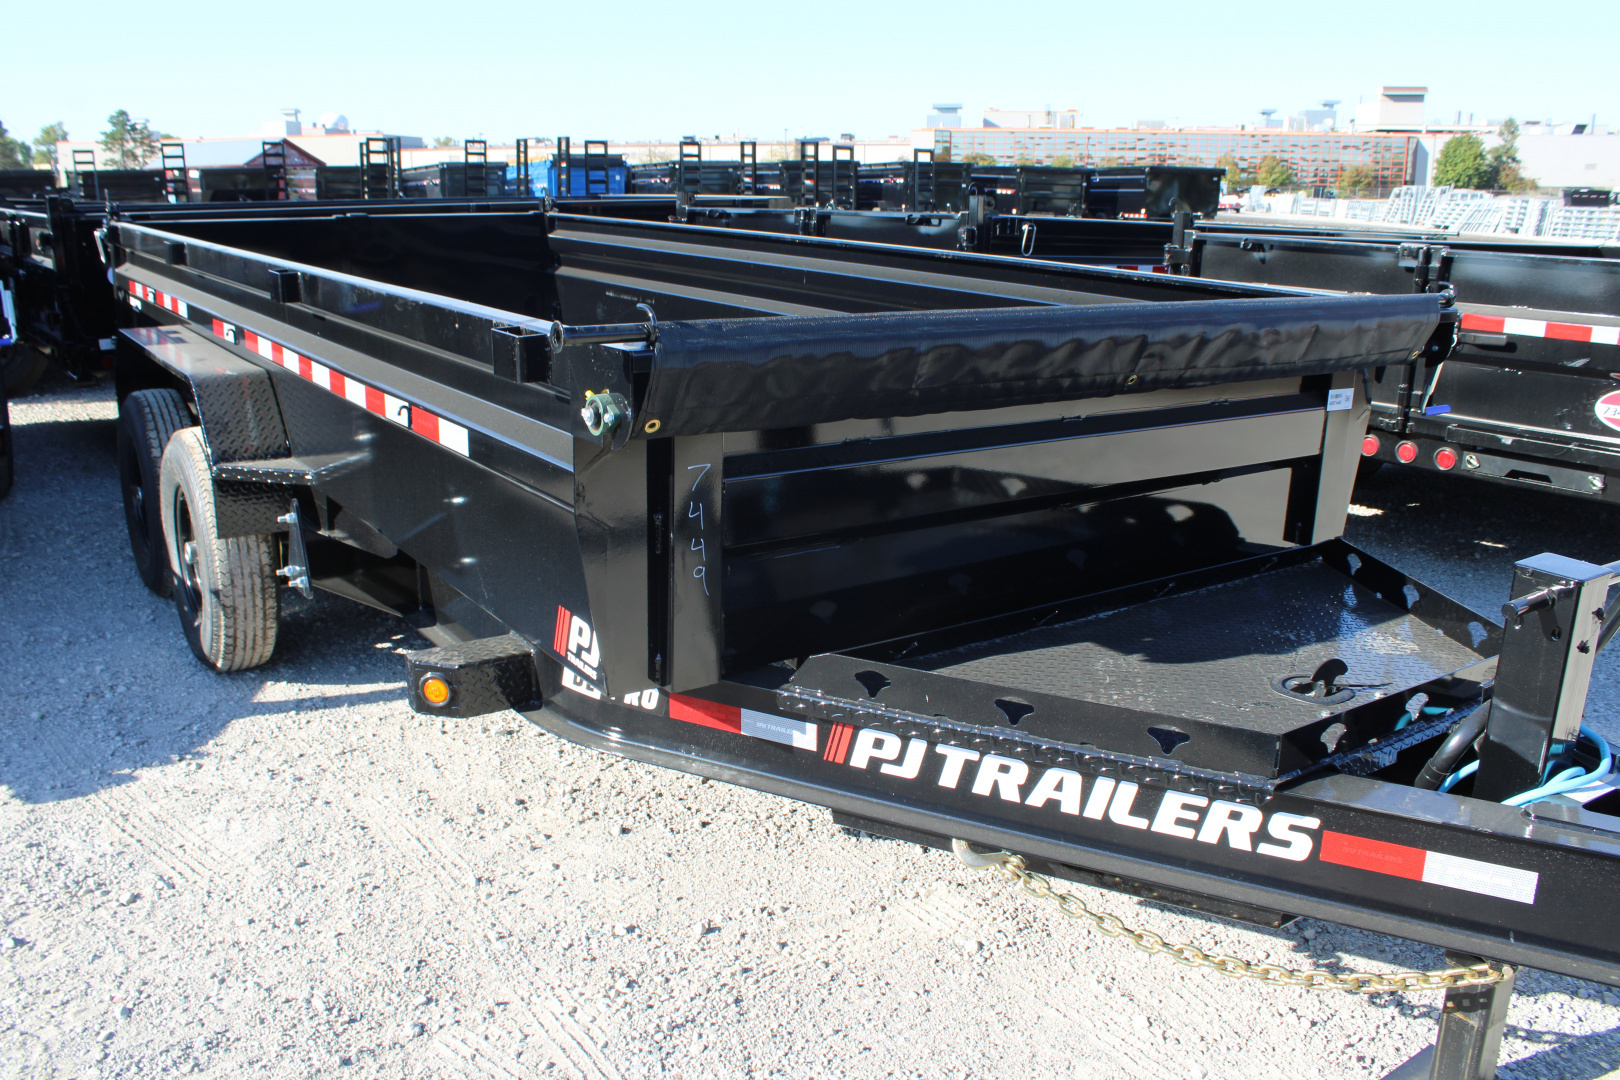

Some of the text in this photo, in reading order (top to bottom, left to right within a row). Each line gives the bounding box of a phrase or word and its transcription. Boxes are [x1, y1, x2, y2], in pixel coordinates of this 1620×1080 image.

[687, 463, 711, 596] 7449
[567, 615, 600, 668] PJ
[567, 652, 598, 681] TRAILERS
[849, 727, 1321, 863] PJ TRAILERS
